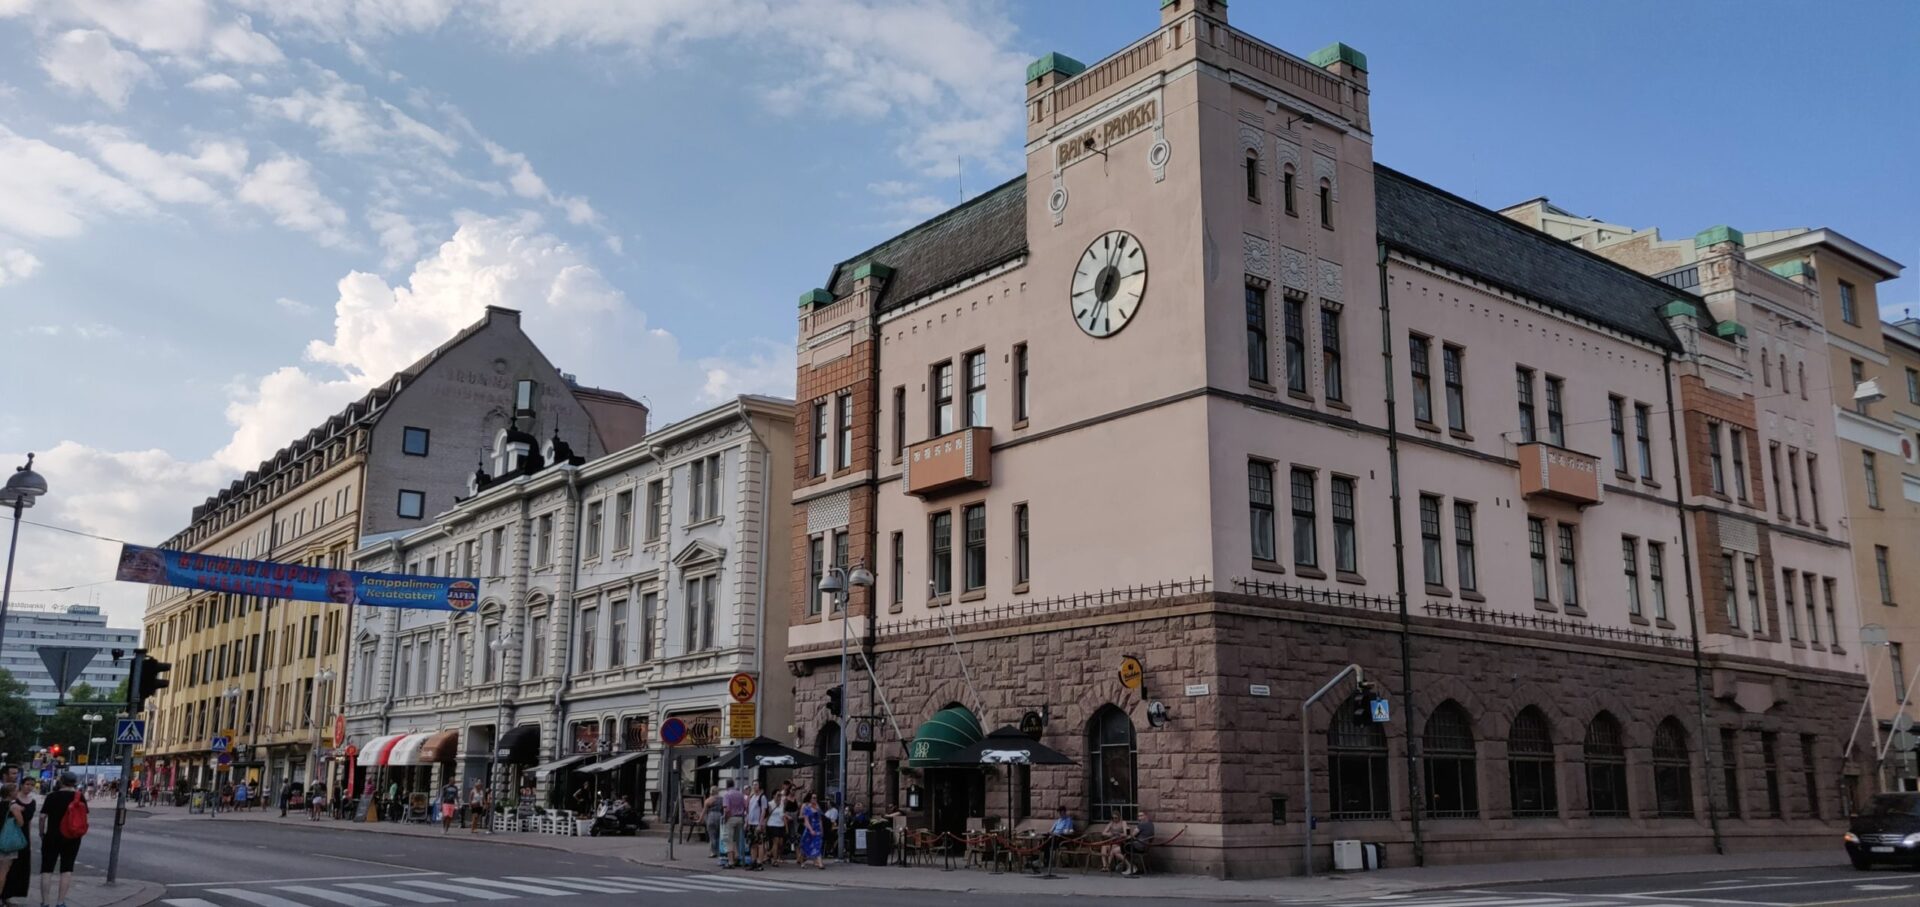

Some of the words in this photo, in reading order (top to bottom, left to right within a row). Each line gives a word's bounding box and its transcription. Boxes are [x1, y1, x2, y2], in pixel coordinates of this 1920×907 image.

[1103, 97, 1157, 144] PANKKI
[361, 576, 444, 590] Samppalinnan
[447, 591, 476, 600] JAFFA
